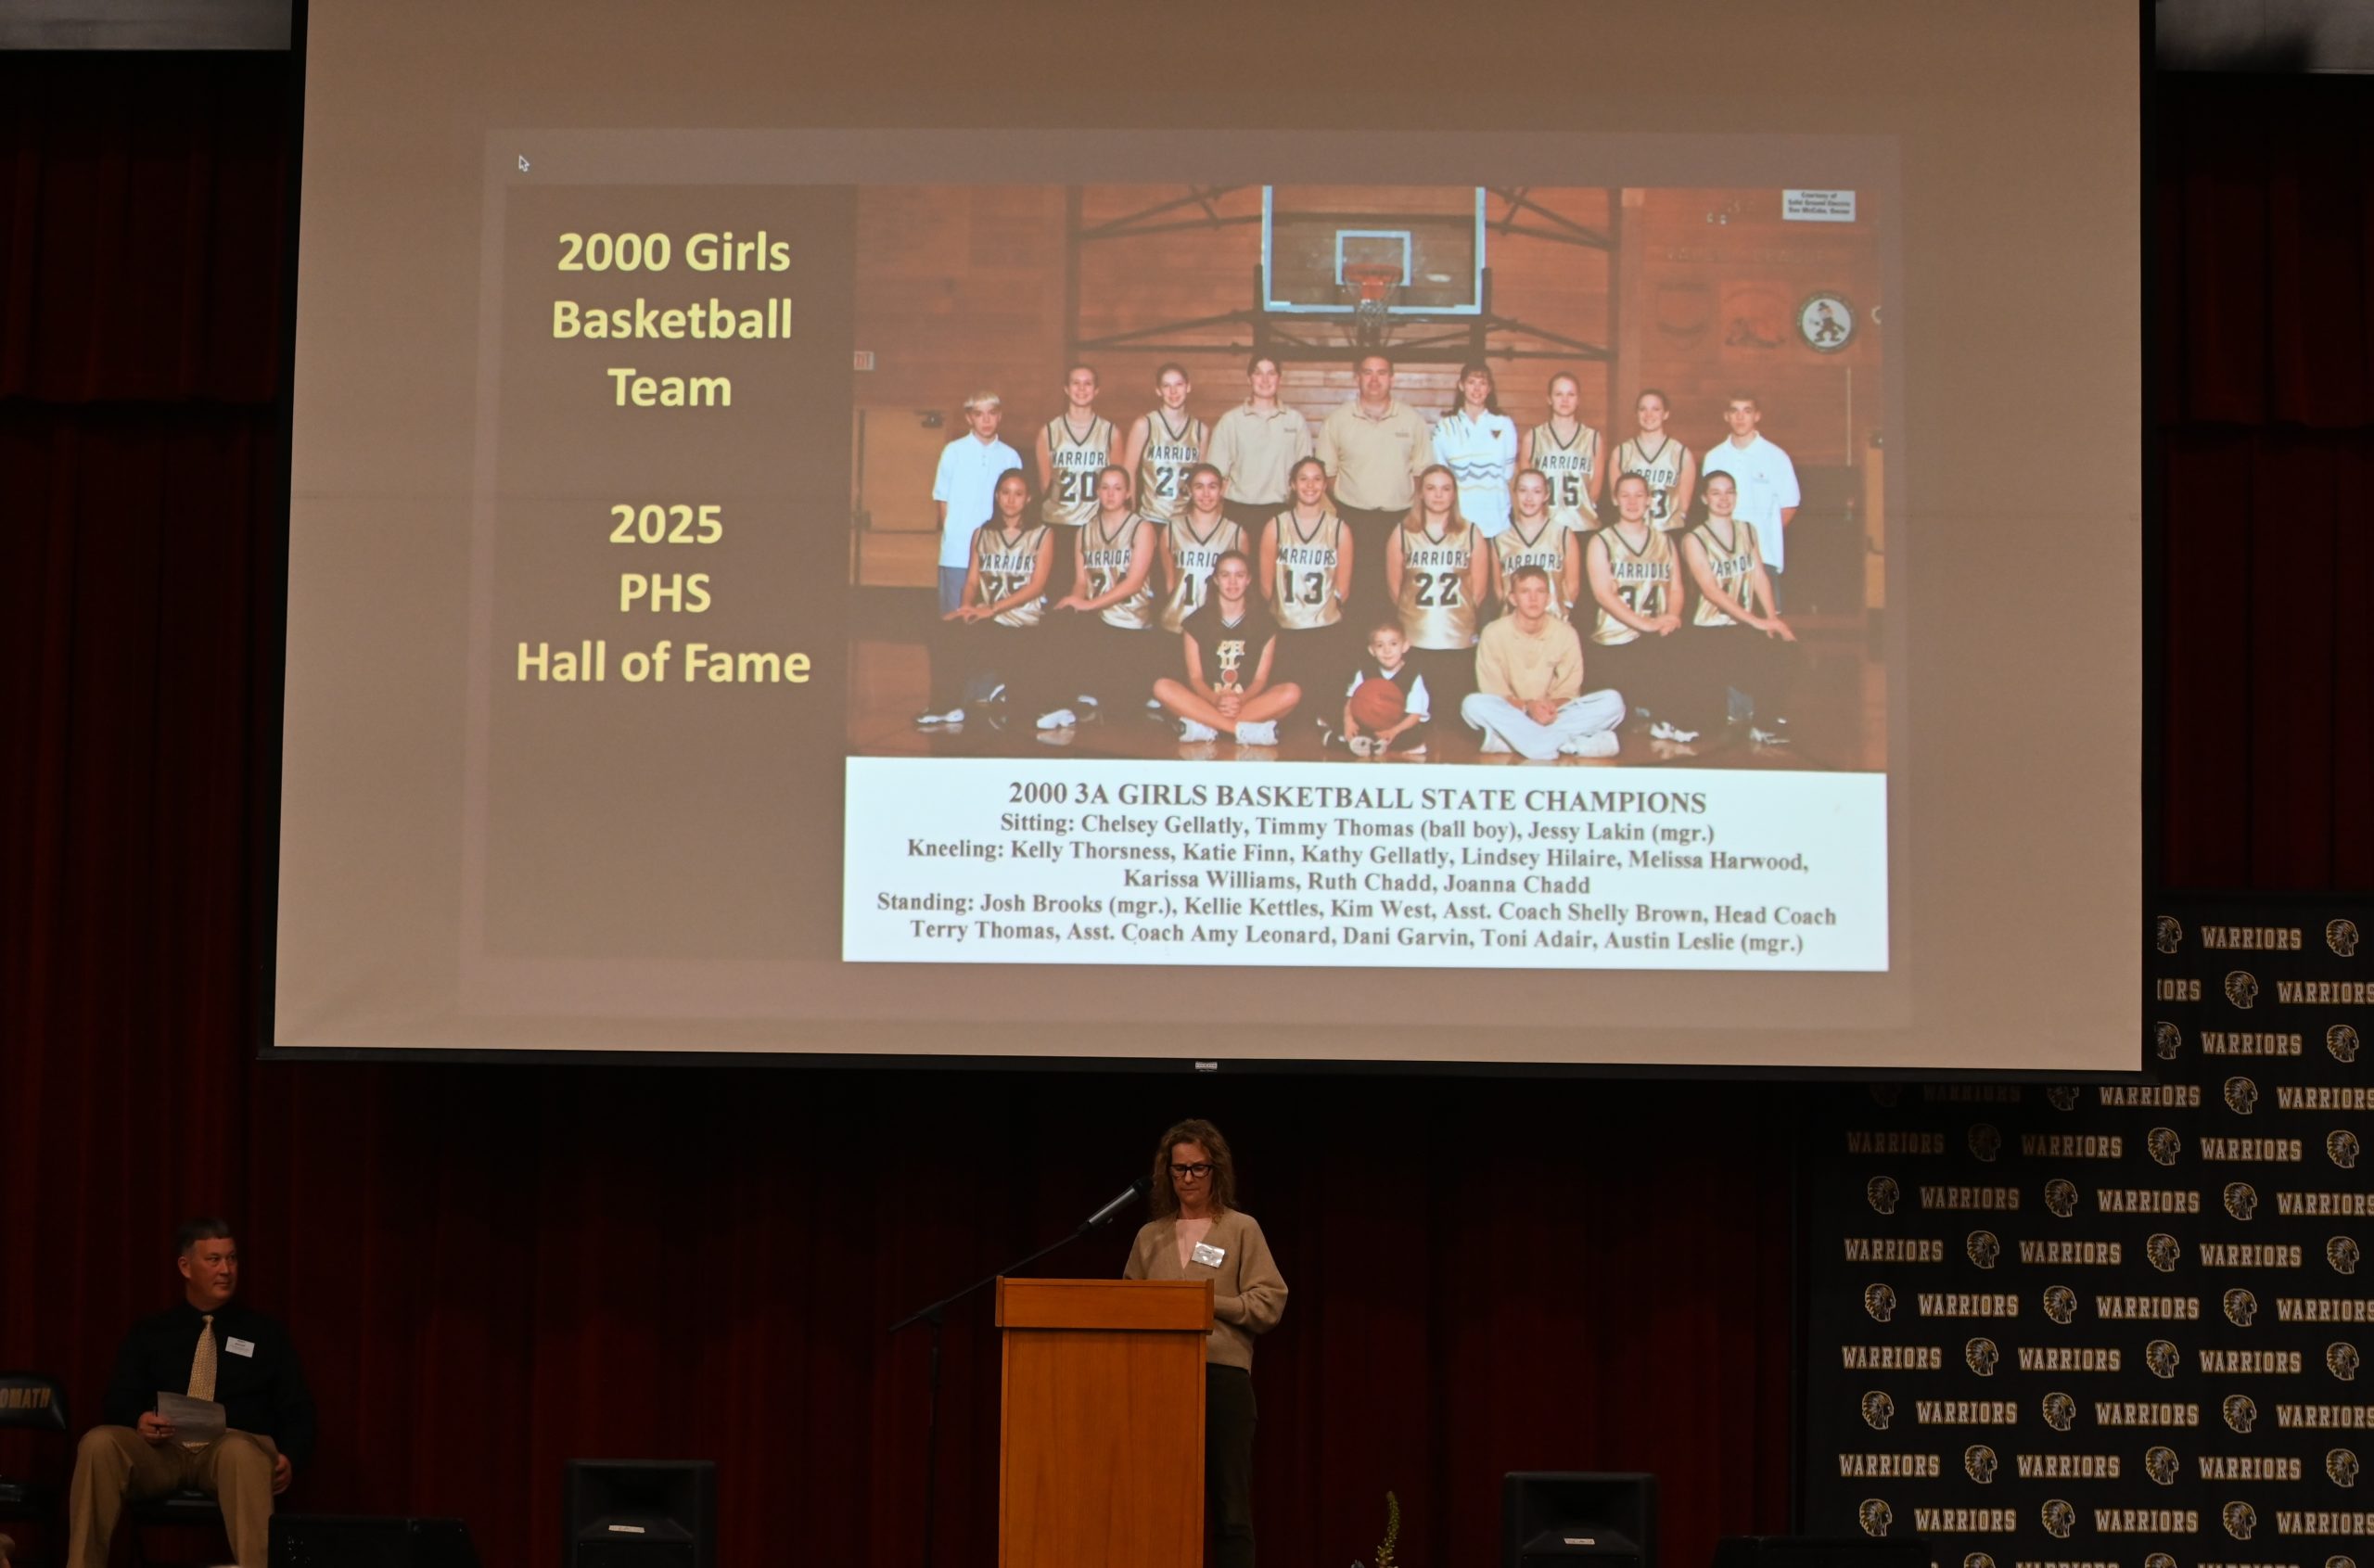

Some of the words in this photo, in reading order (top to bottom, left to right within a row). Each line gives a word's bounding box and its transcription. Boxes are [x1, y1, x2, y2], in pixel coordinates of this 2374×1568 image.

[557, 232, 671, 272] 2000
[685, 230, 791, 272] Girls
[553, 298, 792, 339] Basketball
[606, 367, 732, 407] Team
[1059, 470, 1098, 503] 20
[1548, 476, 1579, 507] 15
[609, 504, 723, 544] 2025
[619, 573, 711, 613] PHS
[1284, 568, 1324, 605] 13
[1413, 572, 1460, 607] 22
[517, 639, 606, 682] Hall
[620, 640, 672, 682] of
[684, 643, 811, 683] Fame
[1009, 781, 1067, 804] 2000
[1074, 782, 1109, 805] 3A
[1117, 783, 1207, 806] GIRLS
[1216, 784, 1413, 809] BASKETBALL
[1422, 788, 1516, 810] STATE
[1525, 789, 1706, 814] CHAMPIONS
[1001, 812, 1074, 836] Sitting:
[1081, 814, 1158, 837] Chelsey
[1164, 815, 1250, 839] Gellatly,
[1256, 816, 1327, 840] Timmy
[1334, 818, 1414, 837] Thomas
[1420, 820, 1465, 840] (ball
[1473, 821, 1523, 843] boy),
[1527, 821, 1580, 844] Jessy
[1587, 822, 1644, 841] Lakin
[1652, 824, 1715, 846] (mgr.)
[908, 838, 1003, 862] Kneeling:
[1011, 839, 1063, 863] Kelly
[1069, 841, 1176, 861] Thorsness,
[1183, 842, 1237, 861] Katie
[1244, 843, 1295, 863] Finn,
[1302, 844, 1363, 868] Kathy
[1370, 846, 1455, 869] Gellatly,
[1462, 847, 1539, 871] Lindsey
[1547, 848, 1622, 868] Hilaire,
[1629, 849, 1703, 869] Melissa
[1710, 850, 1808, 872] Harwood,
[1124, 868, 1199, 888] Karissa
[1206, 870, 1301, 891] Williams,
[1308, 872, 1357, 890] Ruth
[1364, 873, 1438, 893] Chadd,
[1443, 873, 1516, 893] Joanna
[1523, 875, 1590, 894] Chadd
[877, 892, 974, 916] Standing:
[979, 893, 1026, 912] Josh
[1033, 894, 1103, 913] Brooks
[1109, 897, 1178, 919] (mgr.),
[1184, 896, 1242, 915] Kellie
[1249, 898, 1324, 917] Kettles,
[1332, 899, 1373, 917] Kim
[1380, 899, 1436, 919] West,
[1443, 901, 1491, 919] Asst.
[1498, 901, 1562, 921] Coach
[1568, 902, 1627, 926] Shelly
[1636, 903, 1709, 924] Brown,
[1715, 905, 1767, 924] Head
[1773, 906, 1836, 925] Coach
[910, 919, 968, 943] Terry
[975, 921, 1061, 941] Thomas,
[1067, 923, 1115, 940] Asst.
[1121, 923, 1184, 941] Coach
[1191, 924, 1238, 947] Amy
[1245, 924, 1337, 945] Leonard,
[1344, 926, 1390, 945] Dani
[1397, 927, 1474, 947] Garvin,
[1480, 928, 1526, 947] Toni
[1534, 930, 1598, 949] Adair,
[1604, 931, 1670, 950] Austin
[1678, 932, 1734, 950] Leslie
[1741, 934, 1804, 954] (mgr.)
[2202, 926, 2302, 950] WARRIORS
[2277, 981, 2374, 1004] WARRIORS
[2201, 1031, 2302, 1055] WARRIORS
[2100, 1085, 2201, 1107] WARRIORS
[2277, 1087, 2374, 1110] WARRIORS
[1846, 1131, 1946, 1155] WARRIORS
[2021, 1134, 2123, 1159] WARRIORS
[2201, 1138, 2302, 1162] WARRIORS
[1921, 1187, 2020, 1210] WARRIORS
[2098, 1190, 2200, 1213] WARRIORS
[2277, 1192, 2374, 1217] WARRIORS
[1844, 1239, 1943, 1262] WARRIORS
[2020, 1241, 2122, 1265] WARRIORS
[2200, 1243, 2302, 1268] WARRIORS
[1918, 1294, 2019, 1317] WARRIORS
[2096, 1296, 2200, 1319] WARRIORS
[2277, 1298, 2374, 1322] WARRIORS
[1842, 1345, 1942, 1370] WARRIORS
[2018, 1347, 2121, 1371] WARRIORS
[2199, 1350, 2302, 1373] WARRIORS
[1916, 1401, 2017, 1424] WARRIORS
[2095, 1402, 2199, 1426] WARRIORS
[2276, 1405, 2374, 1429] WARRIORS
[1839, 1454, 1940, 1477] WARRIORS
[2017, 1455, 2120, 1478] WARRIORS
[2199, 1457, 2301, 1480] WARRIORS
[1914, 1509, 2016, 1532] WARRIORS
[2094, 1509, 2199, 1533] WARRIORS
[2276, 1511, 2374, 1536] WARRIORS
